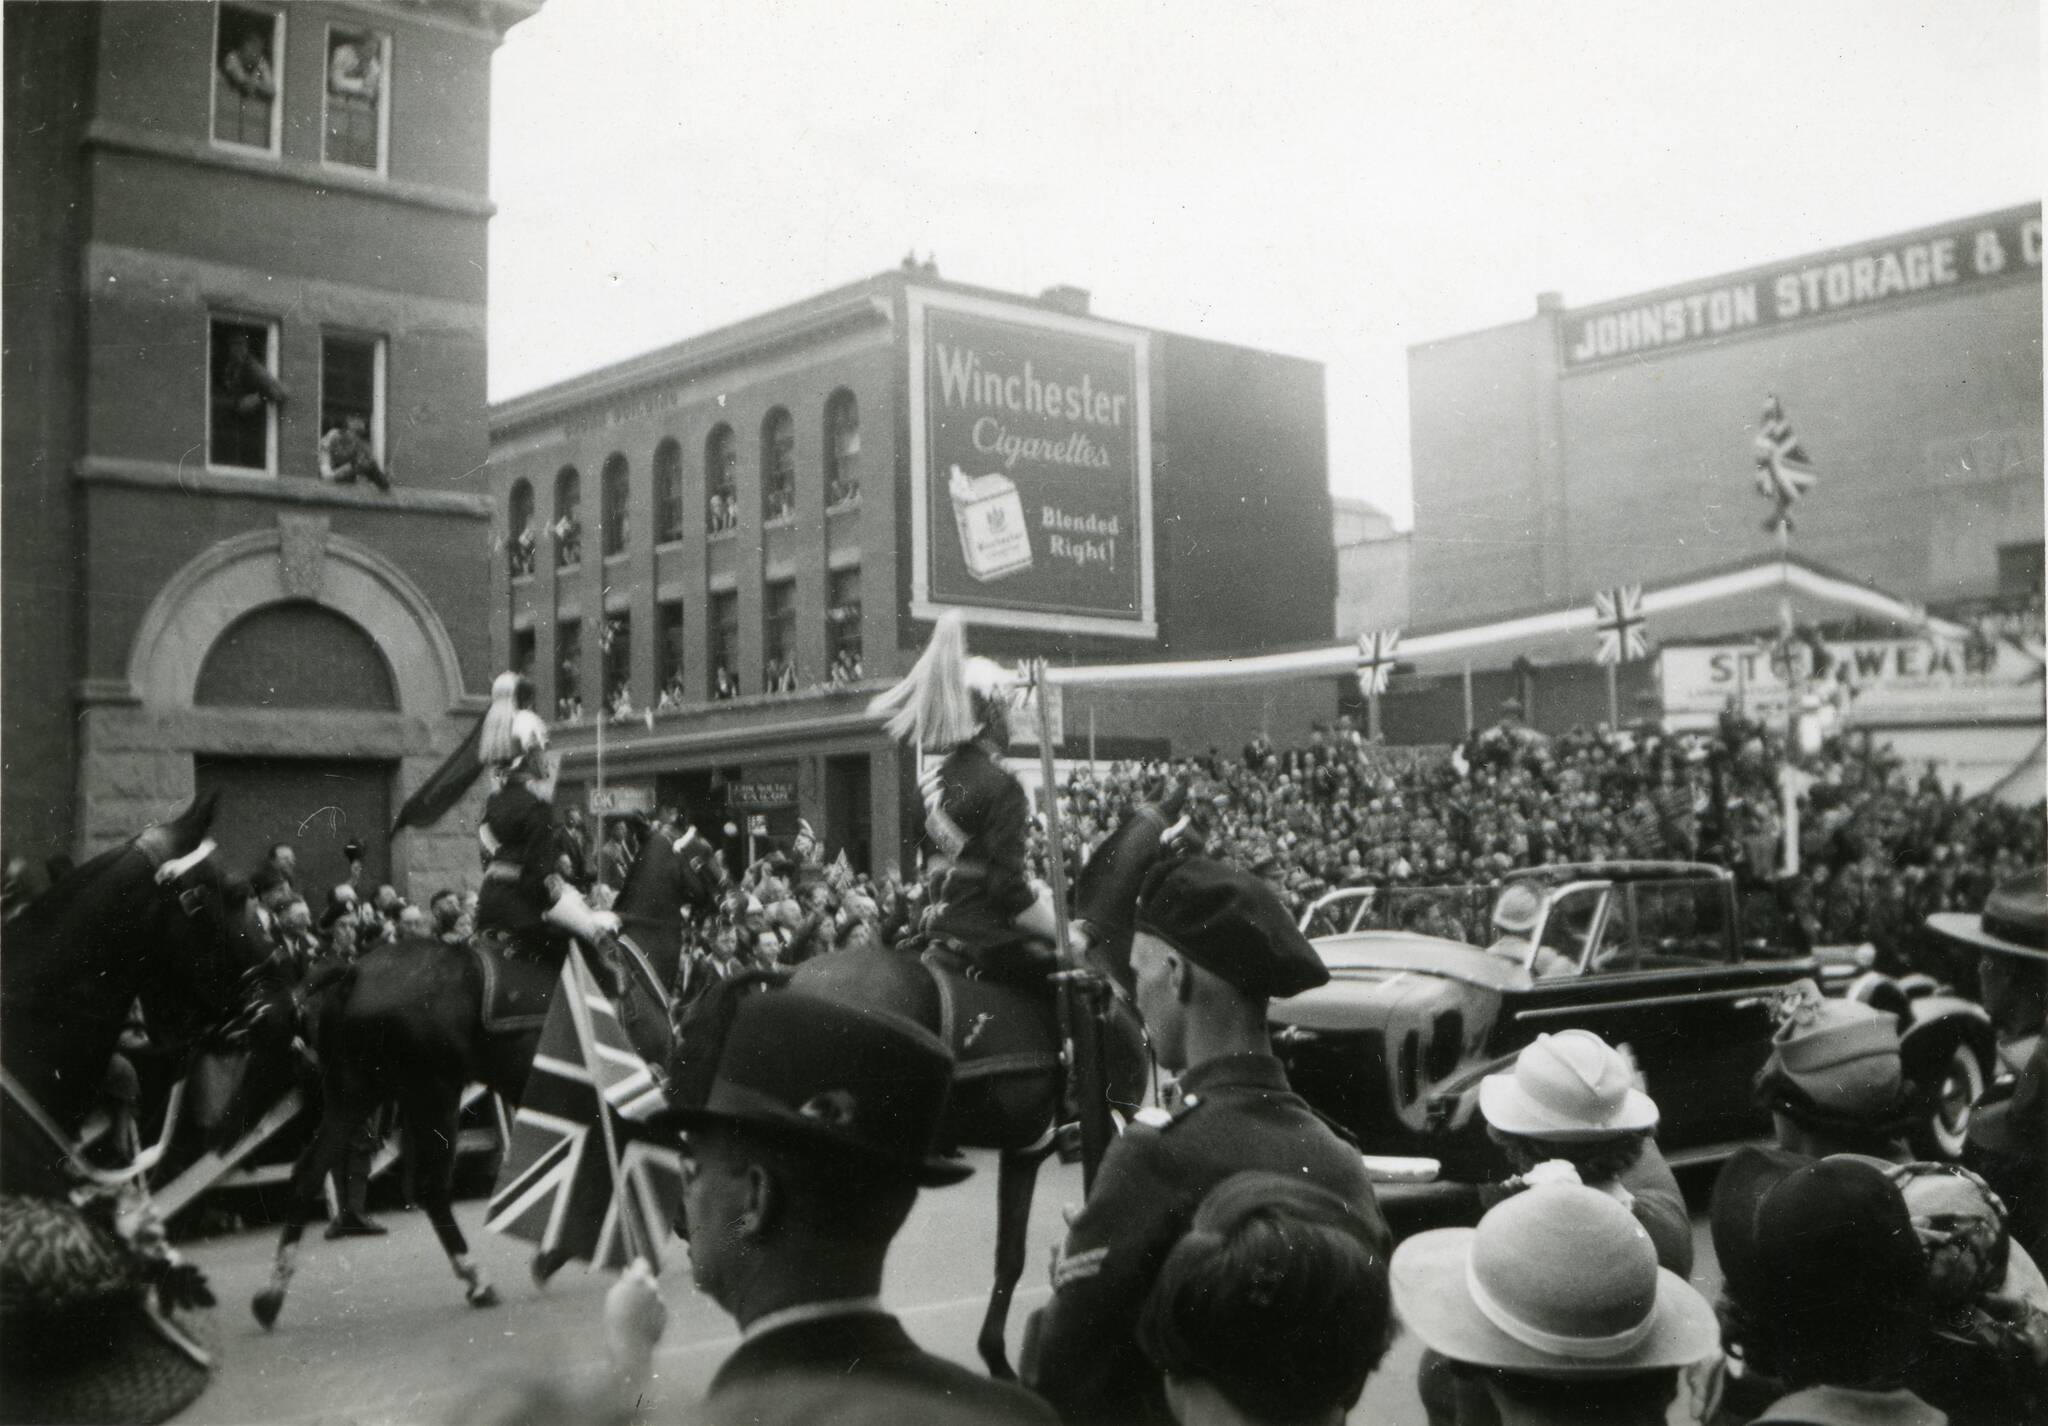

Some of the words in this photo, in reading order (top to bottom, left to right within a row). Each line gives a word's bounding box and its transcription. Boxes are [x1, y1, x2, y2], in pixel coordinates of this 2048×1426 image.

[1576, 286, 1758, 362] JOHNSTON
[1774, 239, 1958, 319] STORAGE
[1974, 231, 2005, 274] &
[937, 343, 1126, 425] Winchester
[972, 416, 1110, 468] Cigarettes
[1042, 506, 1119, 534] Blended
[1051, 534, 1116, 572] Right!
